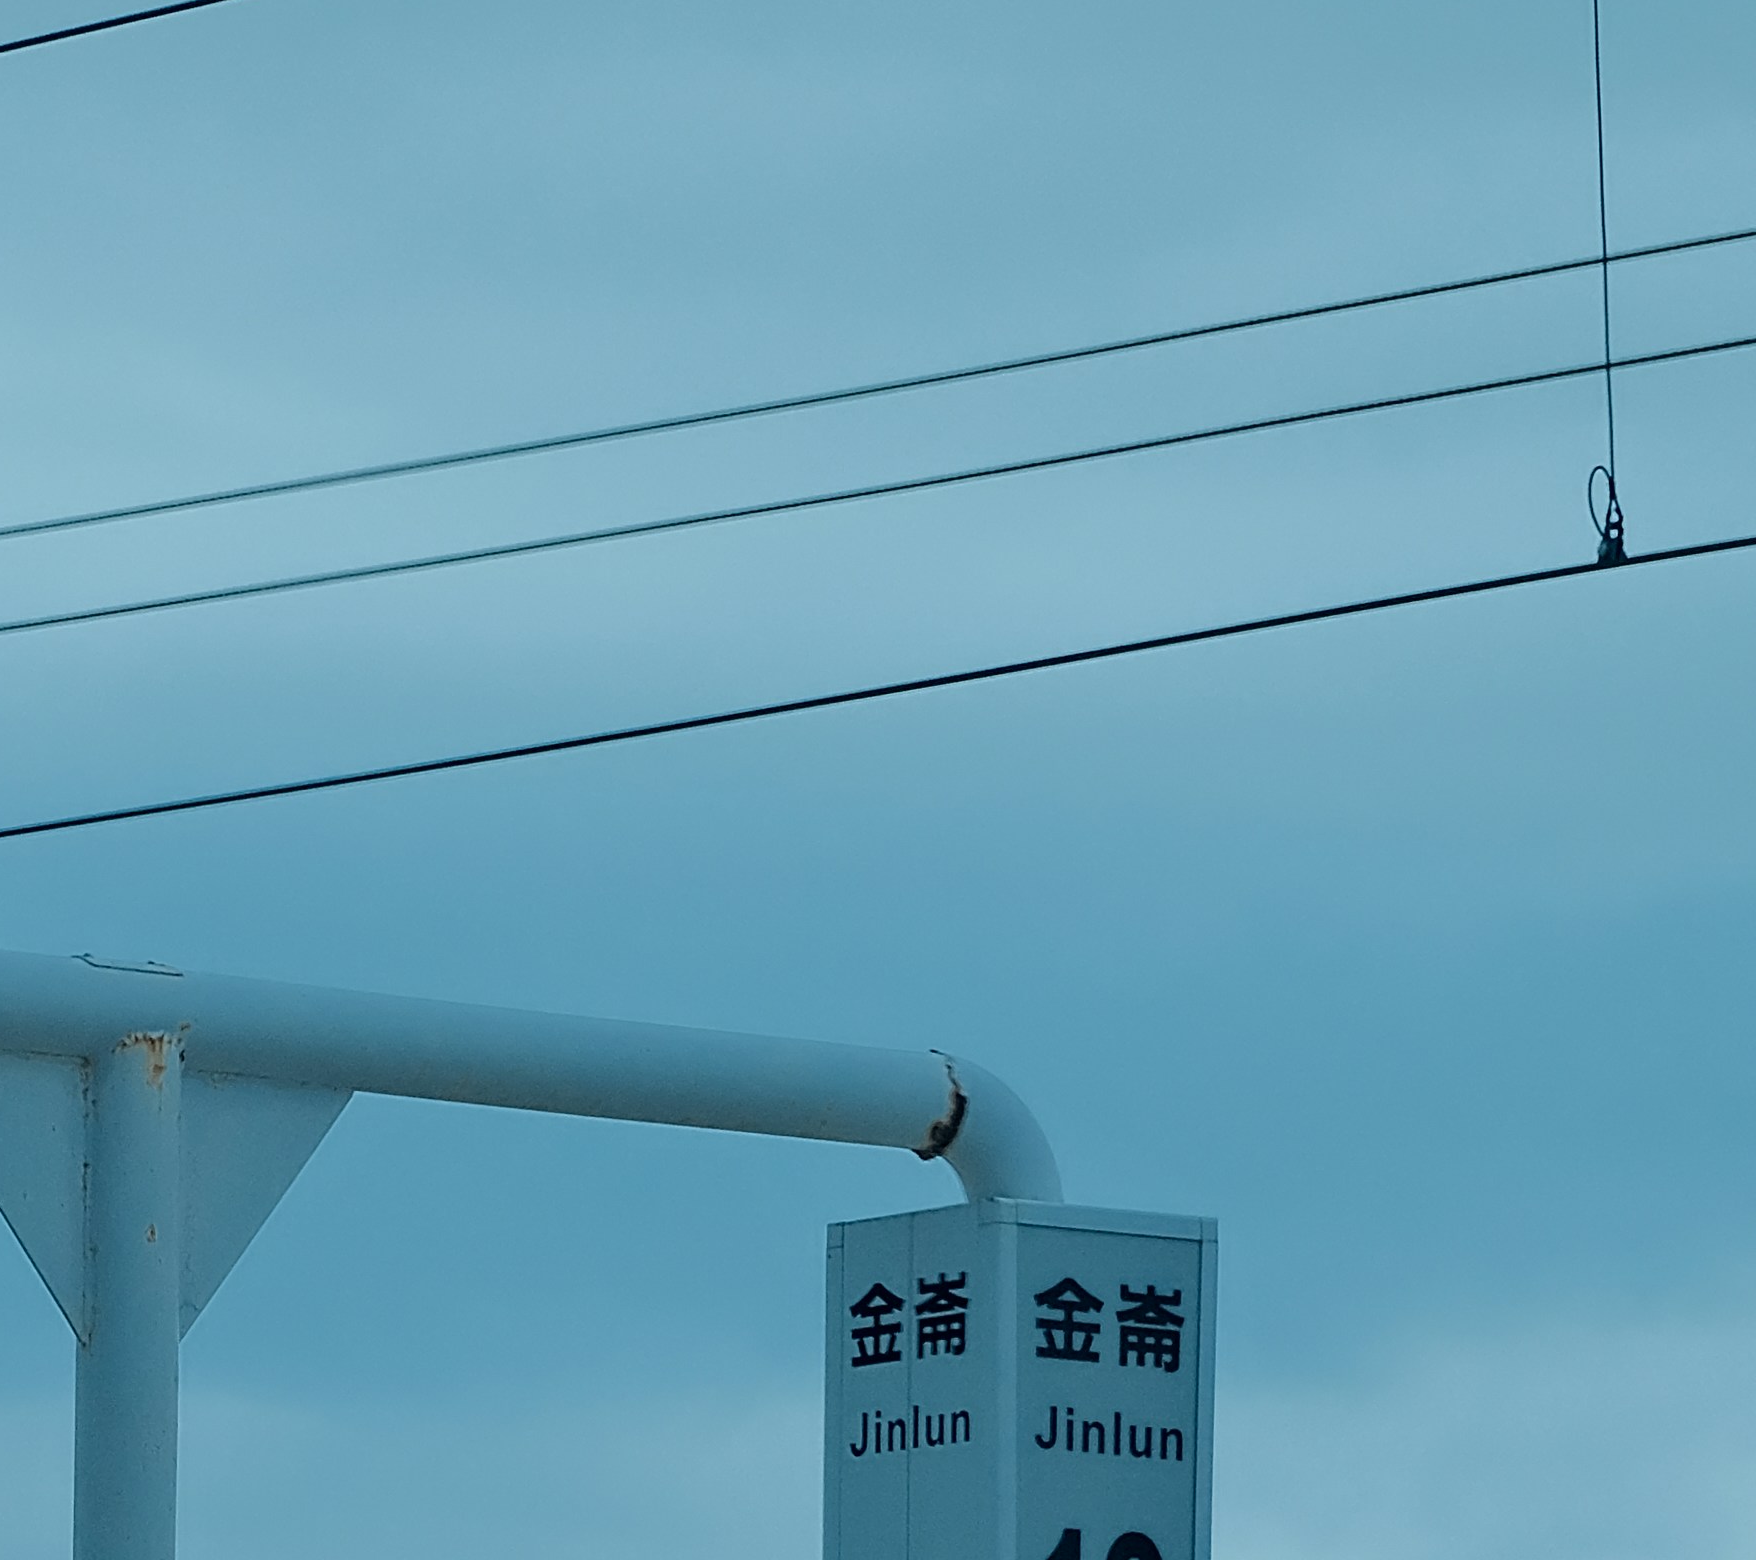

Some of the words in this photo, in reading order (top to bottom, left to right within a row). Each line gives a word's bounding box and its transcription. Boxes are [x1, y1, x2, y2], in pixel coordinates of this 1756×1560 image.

[849, 1271, 969, 1368] 金崙
[1033, 1277, 1185, 1374] 金崙
[849, 1405, 971, 1458] Jinlun
[1034, 1406, 1185, 1463] Jinlun
